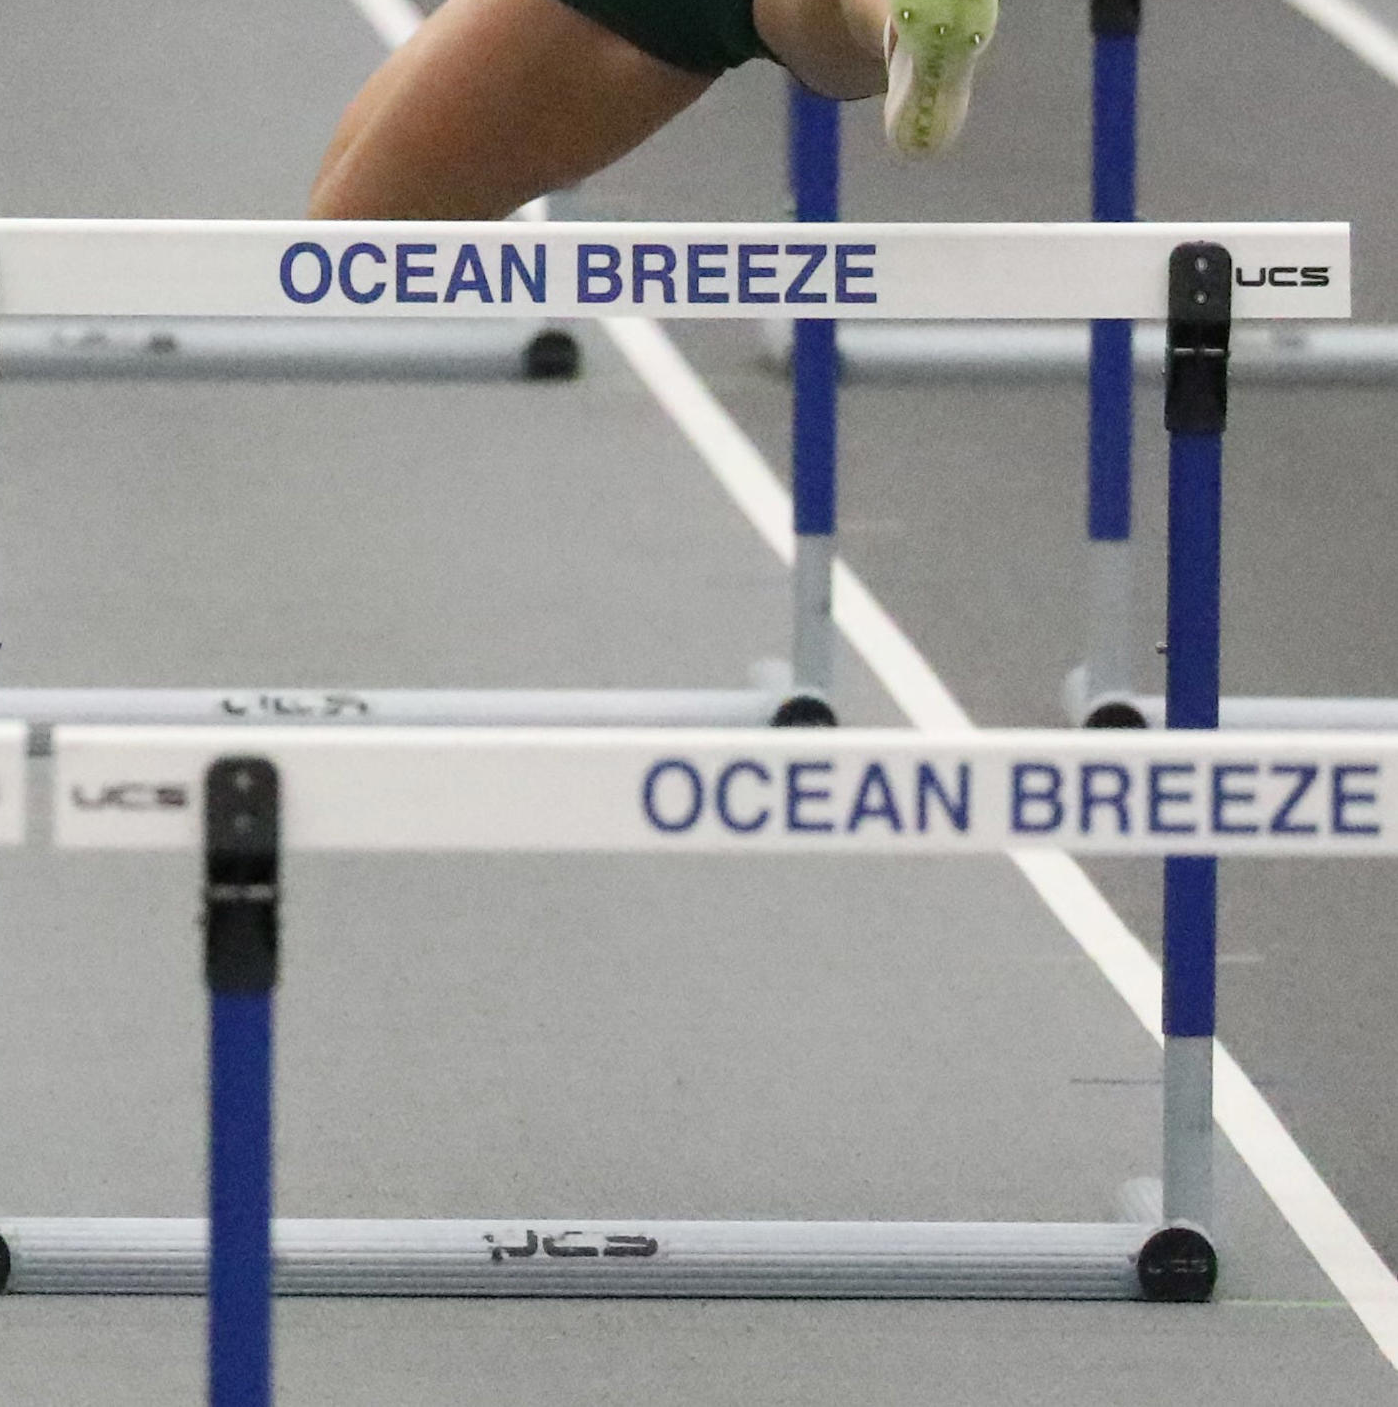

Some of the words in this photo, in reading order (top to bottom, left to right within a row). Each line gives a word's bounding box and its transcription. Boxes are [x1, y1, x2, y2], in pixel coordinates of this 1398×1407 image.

[279, 241, 547, 305] OCEAN
[577, 244, 878, 304] BREEZE
[1236, 265, 1331, 287] UCS
[71, 783, 190, 810] UCS
[642, 758, 972, 833] OCEAN
[1010, 763, 1381, 836] BREEZE
